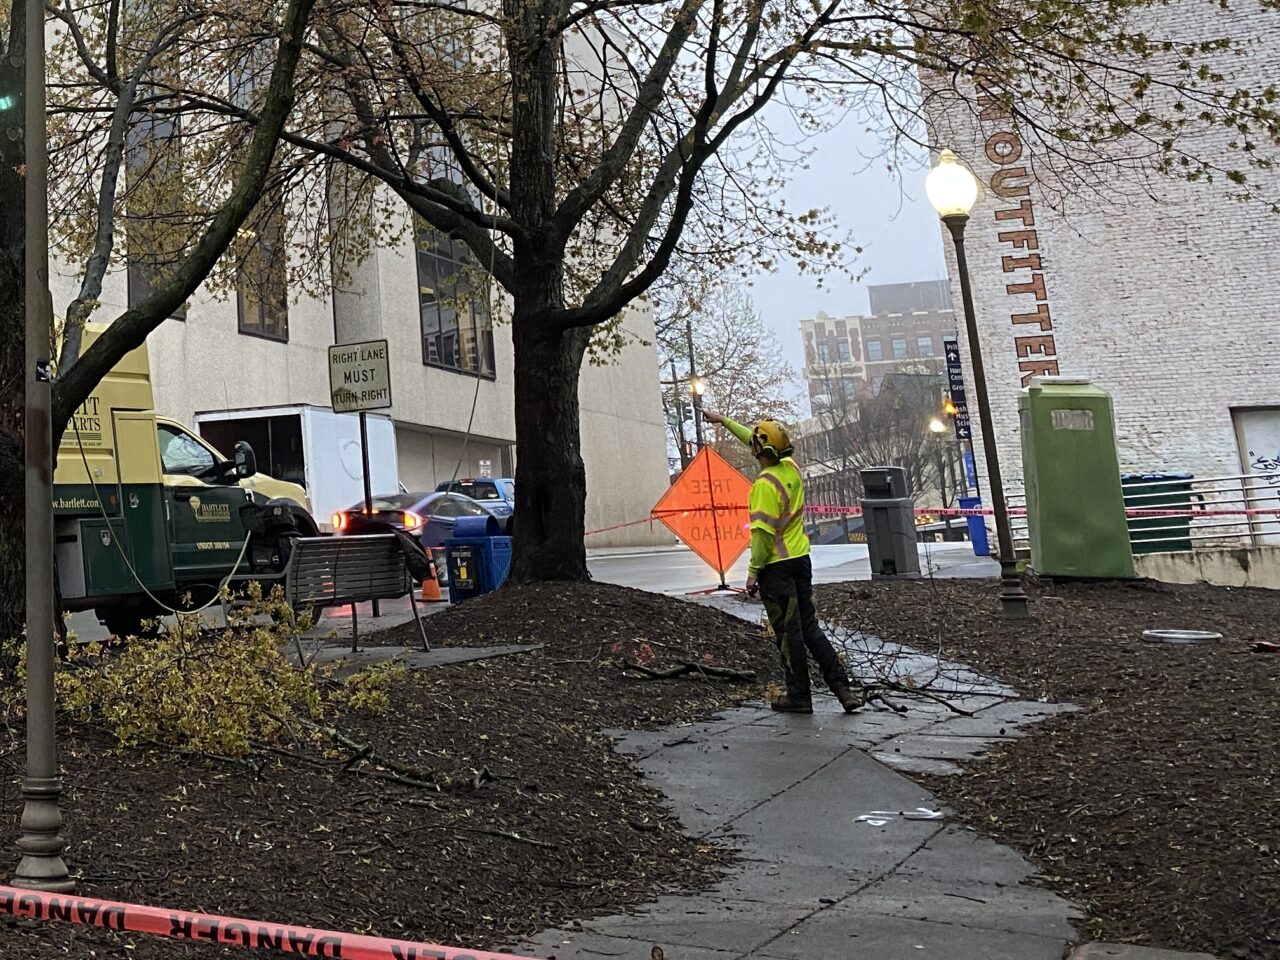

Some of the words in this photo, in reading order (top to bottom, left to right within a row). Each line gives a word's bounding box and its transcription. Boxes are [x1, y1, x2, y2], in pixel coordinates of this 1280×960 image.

[333, 352, 357, 364] RIGHT
[362, 349, 384, 361] LANE
[344, 369, 375, 384] MUST
[334, 392, 357, 404] TURN
[362, 388, 387, 401] RIGHT
[170, 913, 343, 959] DANGER
